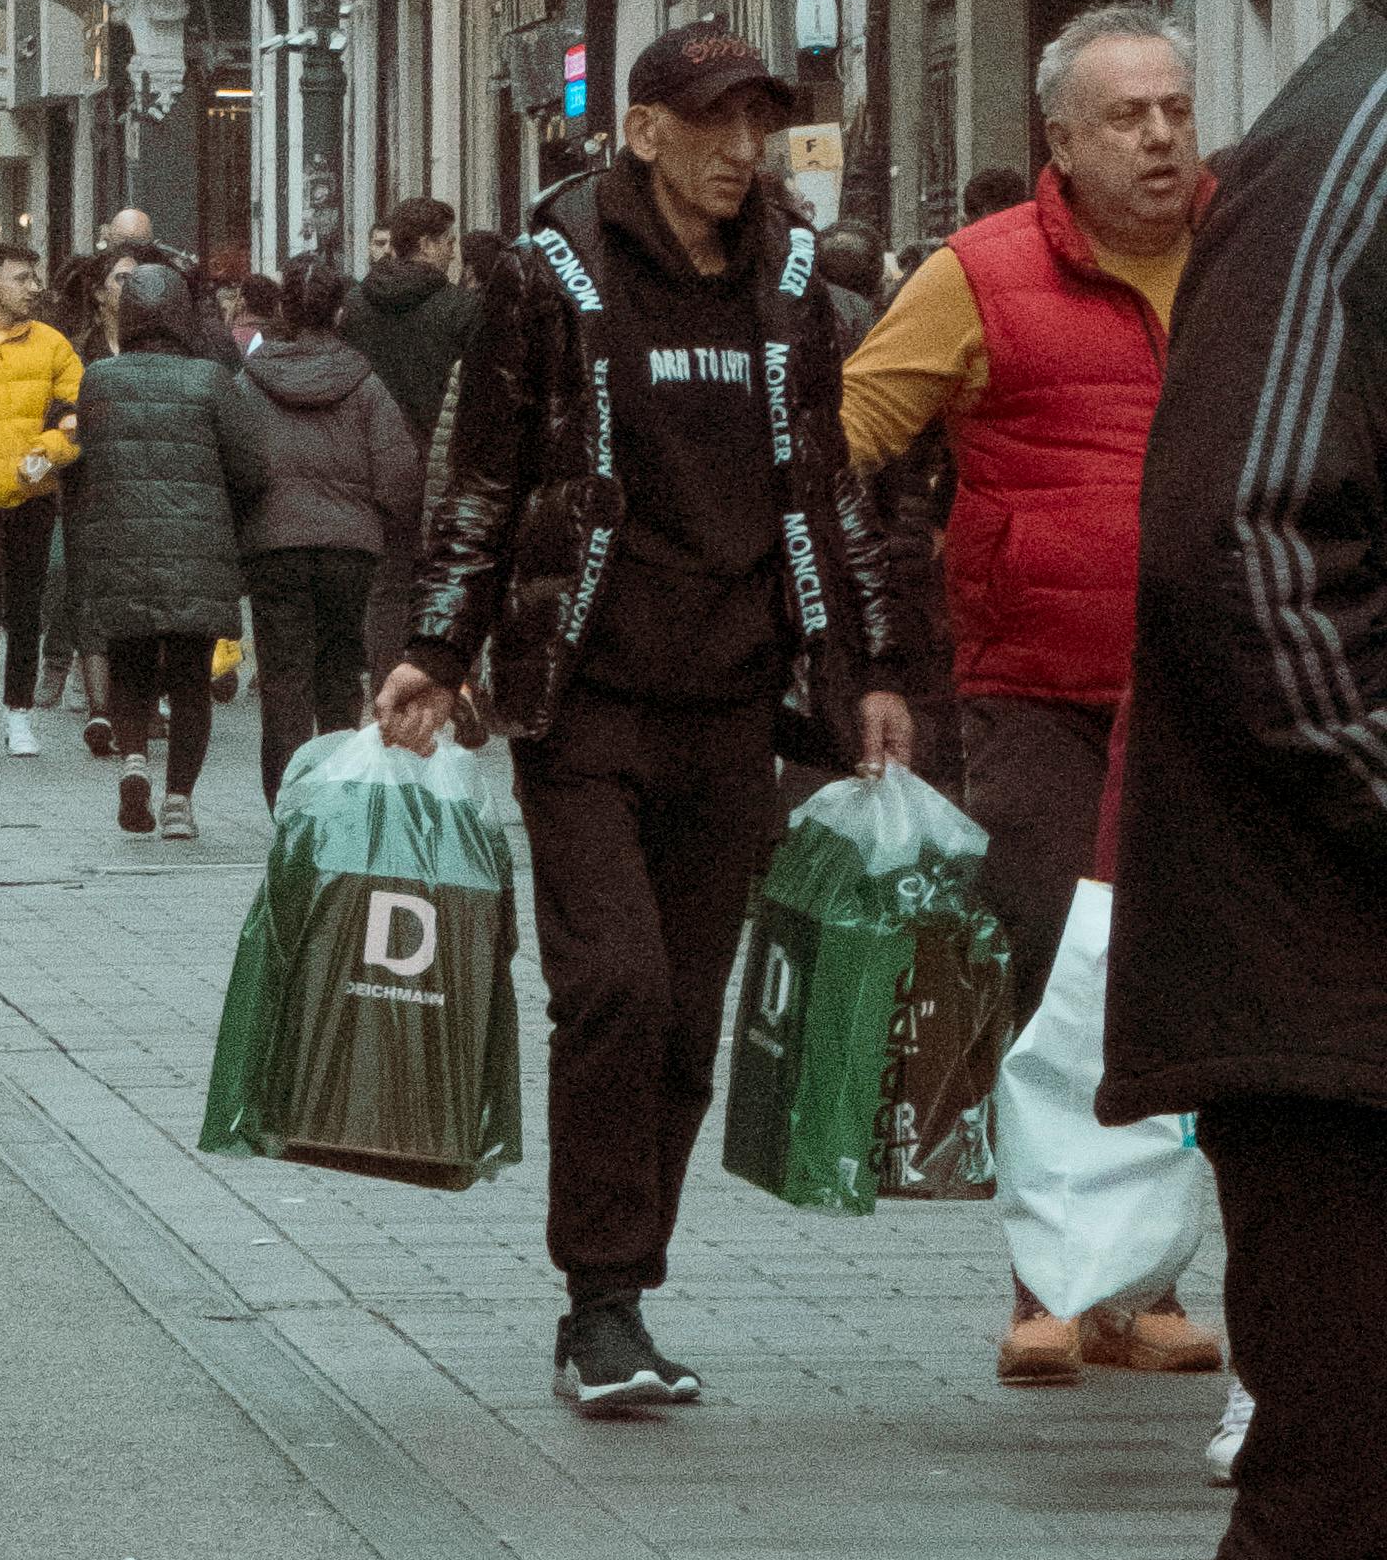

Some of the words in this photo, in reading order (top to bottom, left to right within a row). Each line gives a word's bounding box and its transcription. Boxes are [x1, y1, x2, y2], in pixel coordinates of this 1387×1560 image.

[765, 342, 792, 466] MONCLER
[566, 527, 614, 645] MONCLER
[782, 512, 828, 636] MONCLER
[364, 890, 437, 976] D
